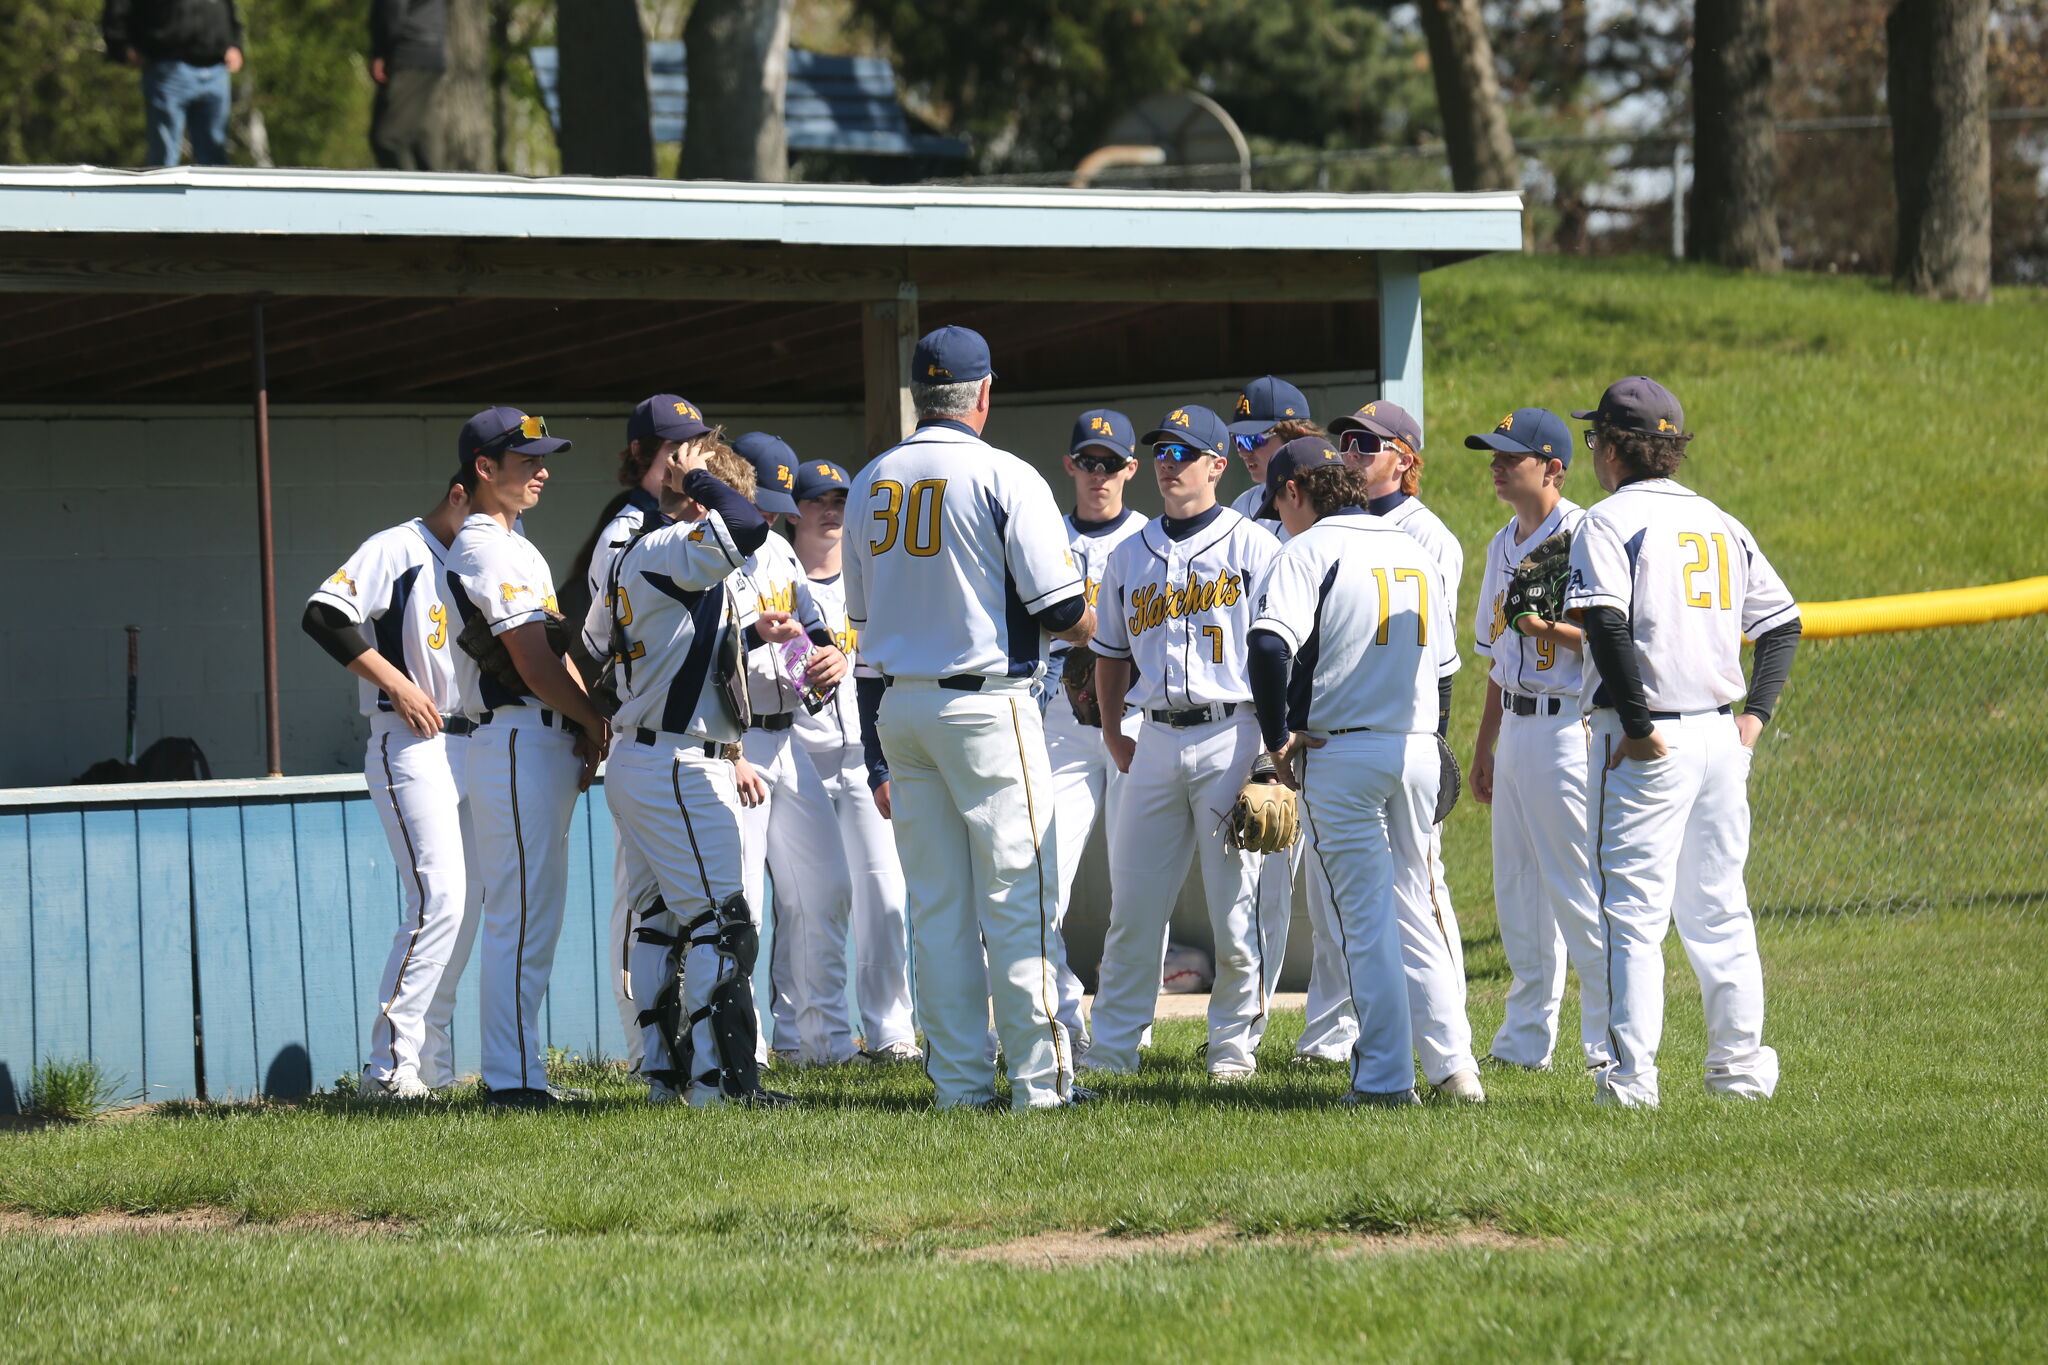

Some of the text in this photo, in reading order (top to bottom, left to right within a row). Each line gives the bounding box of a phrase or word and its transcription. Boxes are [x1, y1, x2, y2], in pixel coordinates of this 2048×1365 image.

[869, 478, 948, 557] 30
[1129, 568, 1241, 637] Hatchets
[1371, 567, 1428, 647] 17
[1678, 532, 1732, 610] 21
[1202, 625, 1223, 664] 7
[1535, 636, 1556, 671] 9
